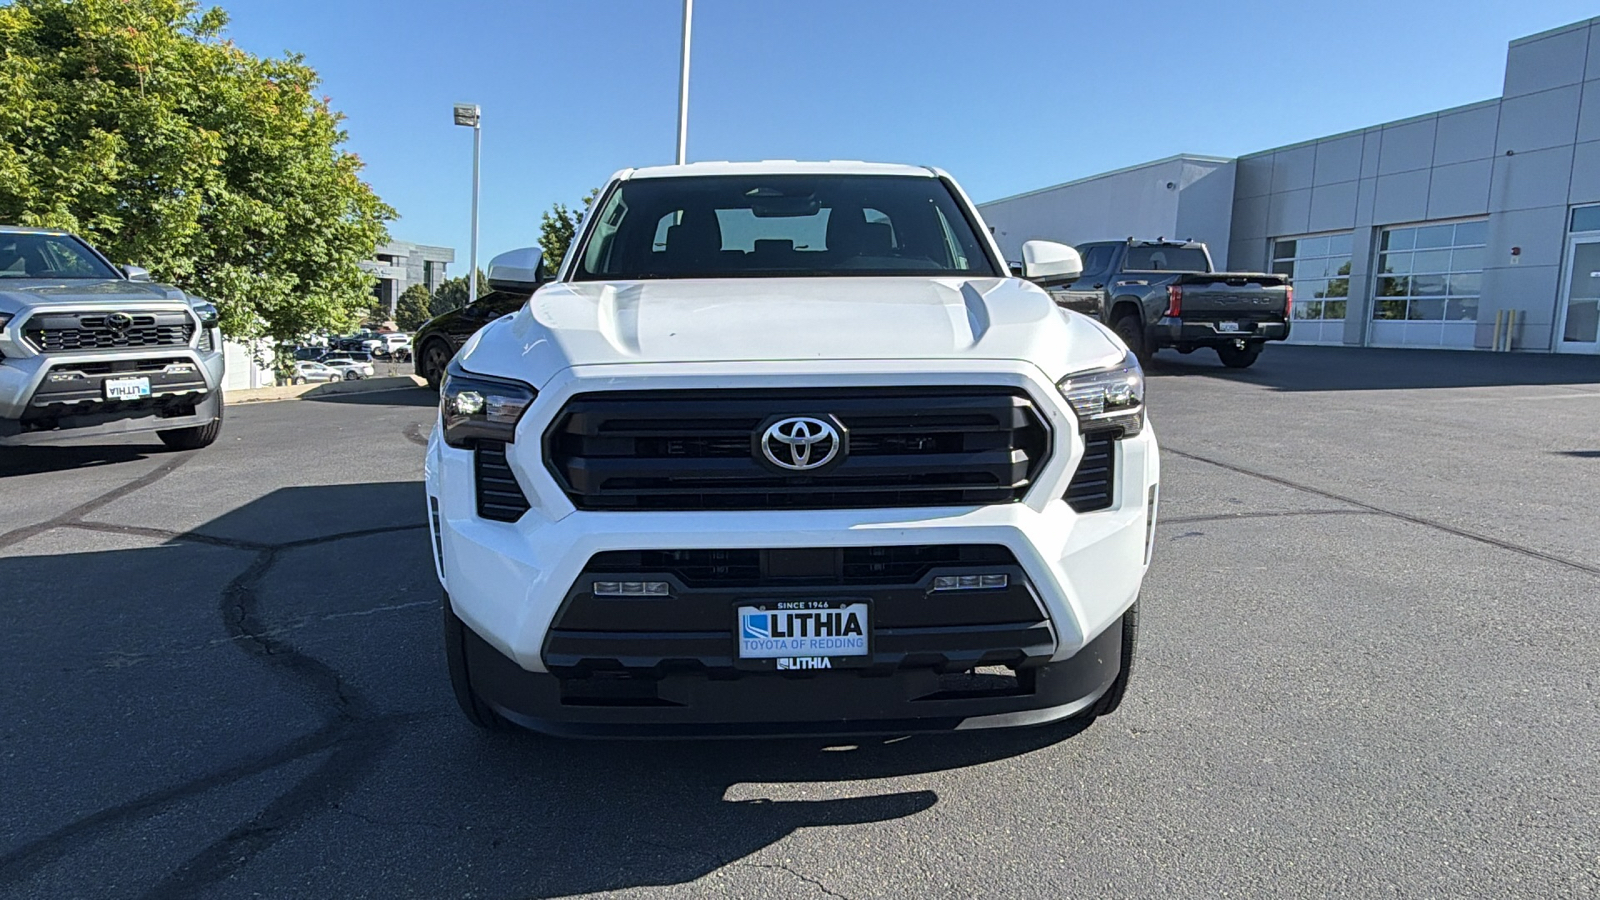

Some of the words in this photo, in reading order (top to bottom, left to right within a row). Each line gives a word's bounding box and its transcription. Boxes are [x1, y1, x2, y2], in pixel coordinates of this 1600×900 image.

[109, 386, 140, 395] LITHIA
[808, 601, 829, 609] 1946
[771, 612, 863, 638] LITHIA
[744, 639, 787, 650] TOYOTA
[791, 639, 806, 650] OF
[810, 638, 864, 649] REDDING
[789, 657, 832, 669] LITHIA
